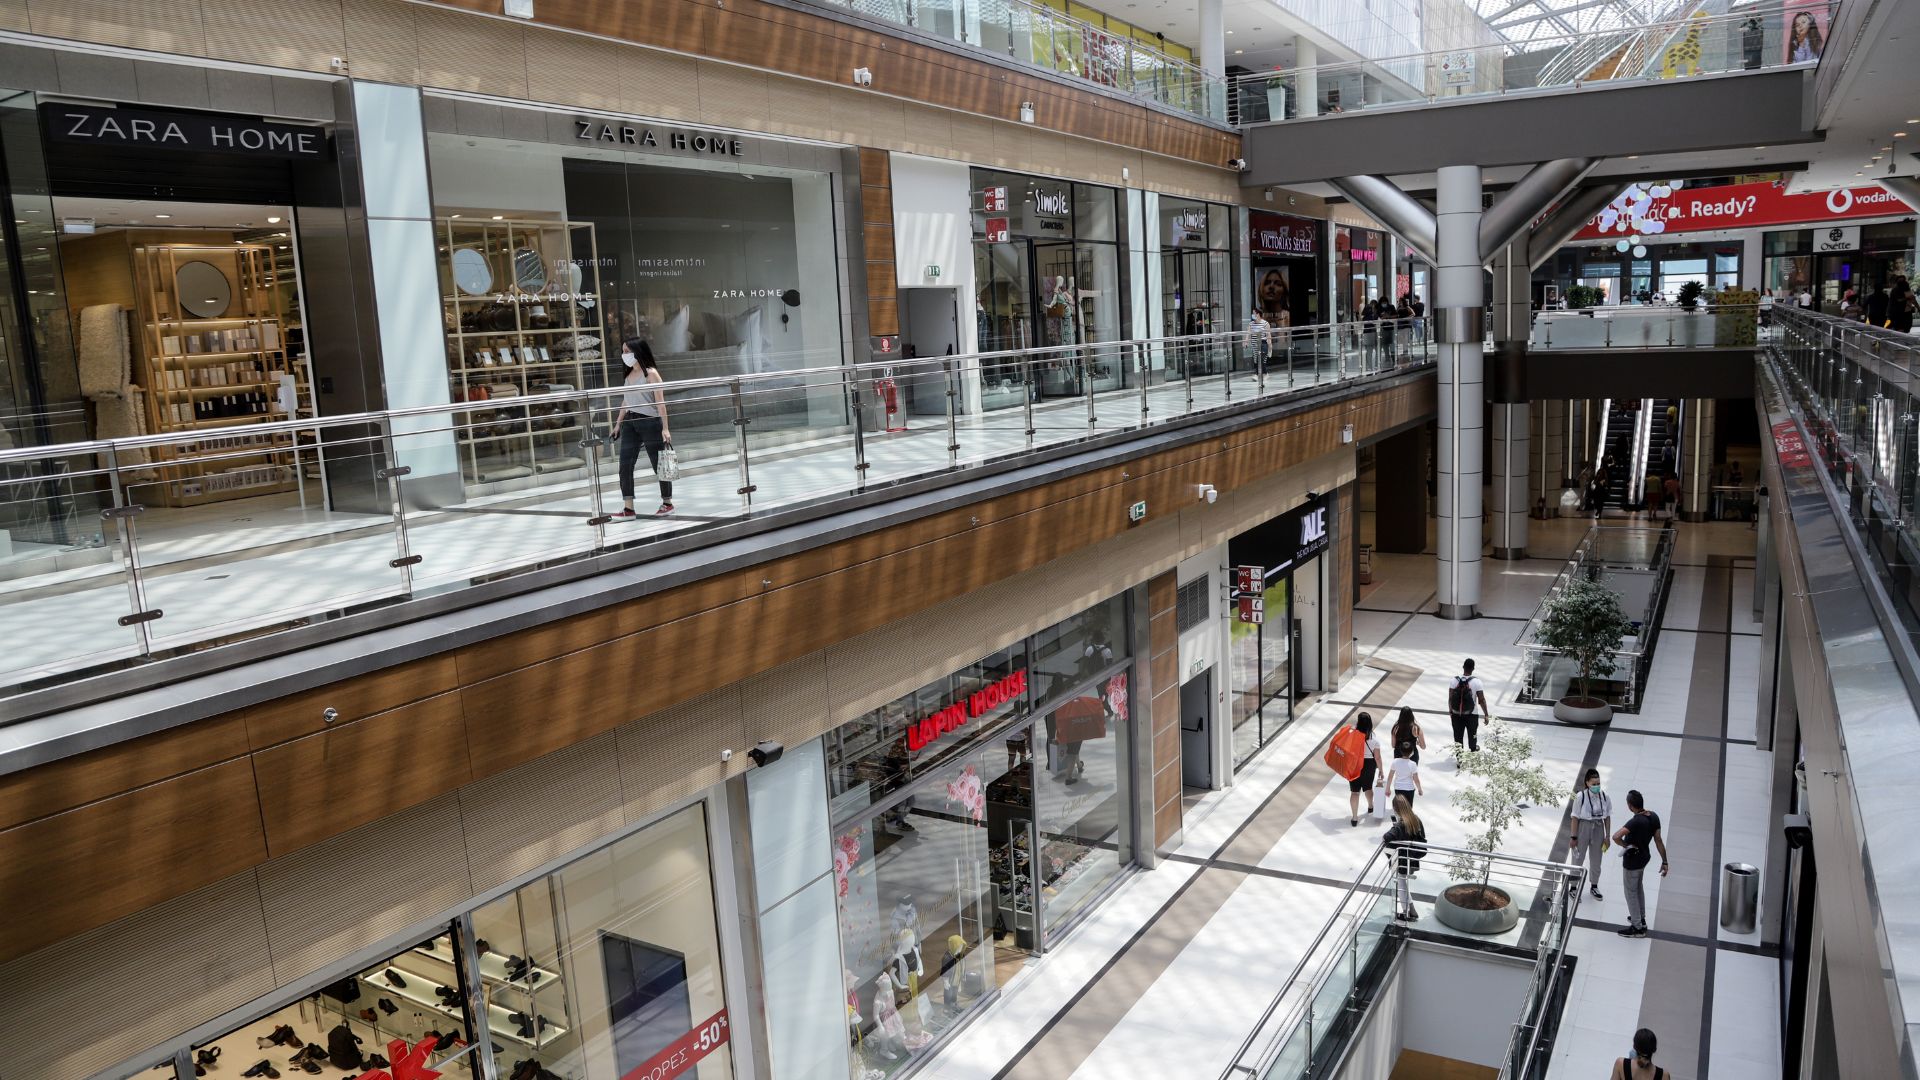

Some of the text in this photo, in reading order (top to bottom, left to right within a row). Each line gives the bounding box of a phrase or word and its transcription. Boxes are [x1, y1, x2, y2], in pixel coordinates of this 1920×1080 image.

[64, 113, 318, 154] ZARA HOME
[577, 120, 745, 156] ZARA HOME
[1691, 195, 1757, 218] Ready?
[1260, 232, 1292, 250] VICTORIA'S
[1293, 236, 1312, 252] SECRET
[1820, 242, 1851, 251] Oxette
[496, 292, 594, 303] ZARA HOME
[713, 289, 782, 299] ZARA HOME
[907, 667, 1028, 751] LAPIN HOUSE
[693, 1016, 728, 1051] -50%
